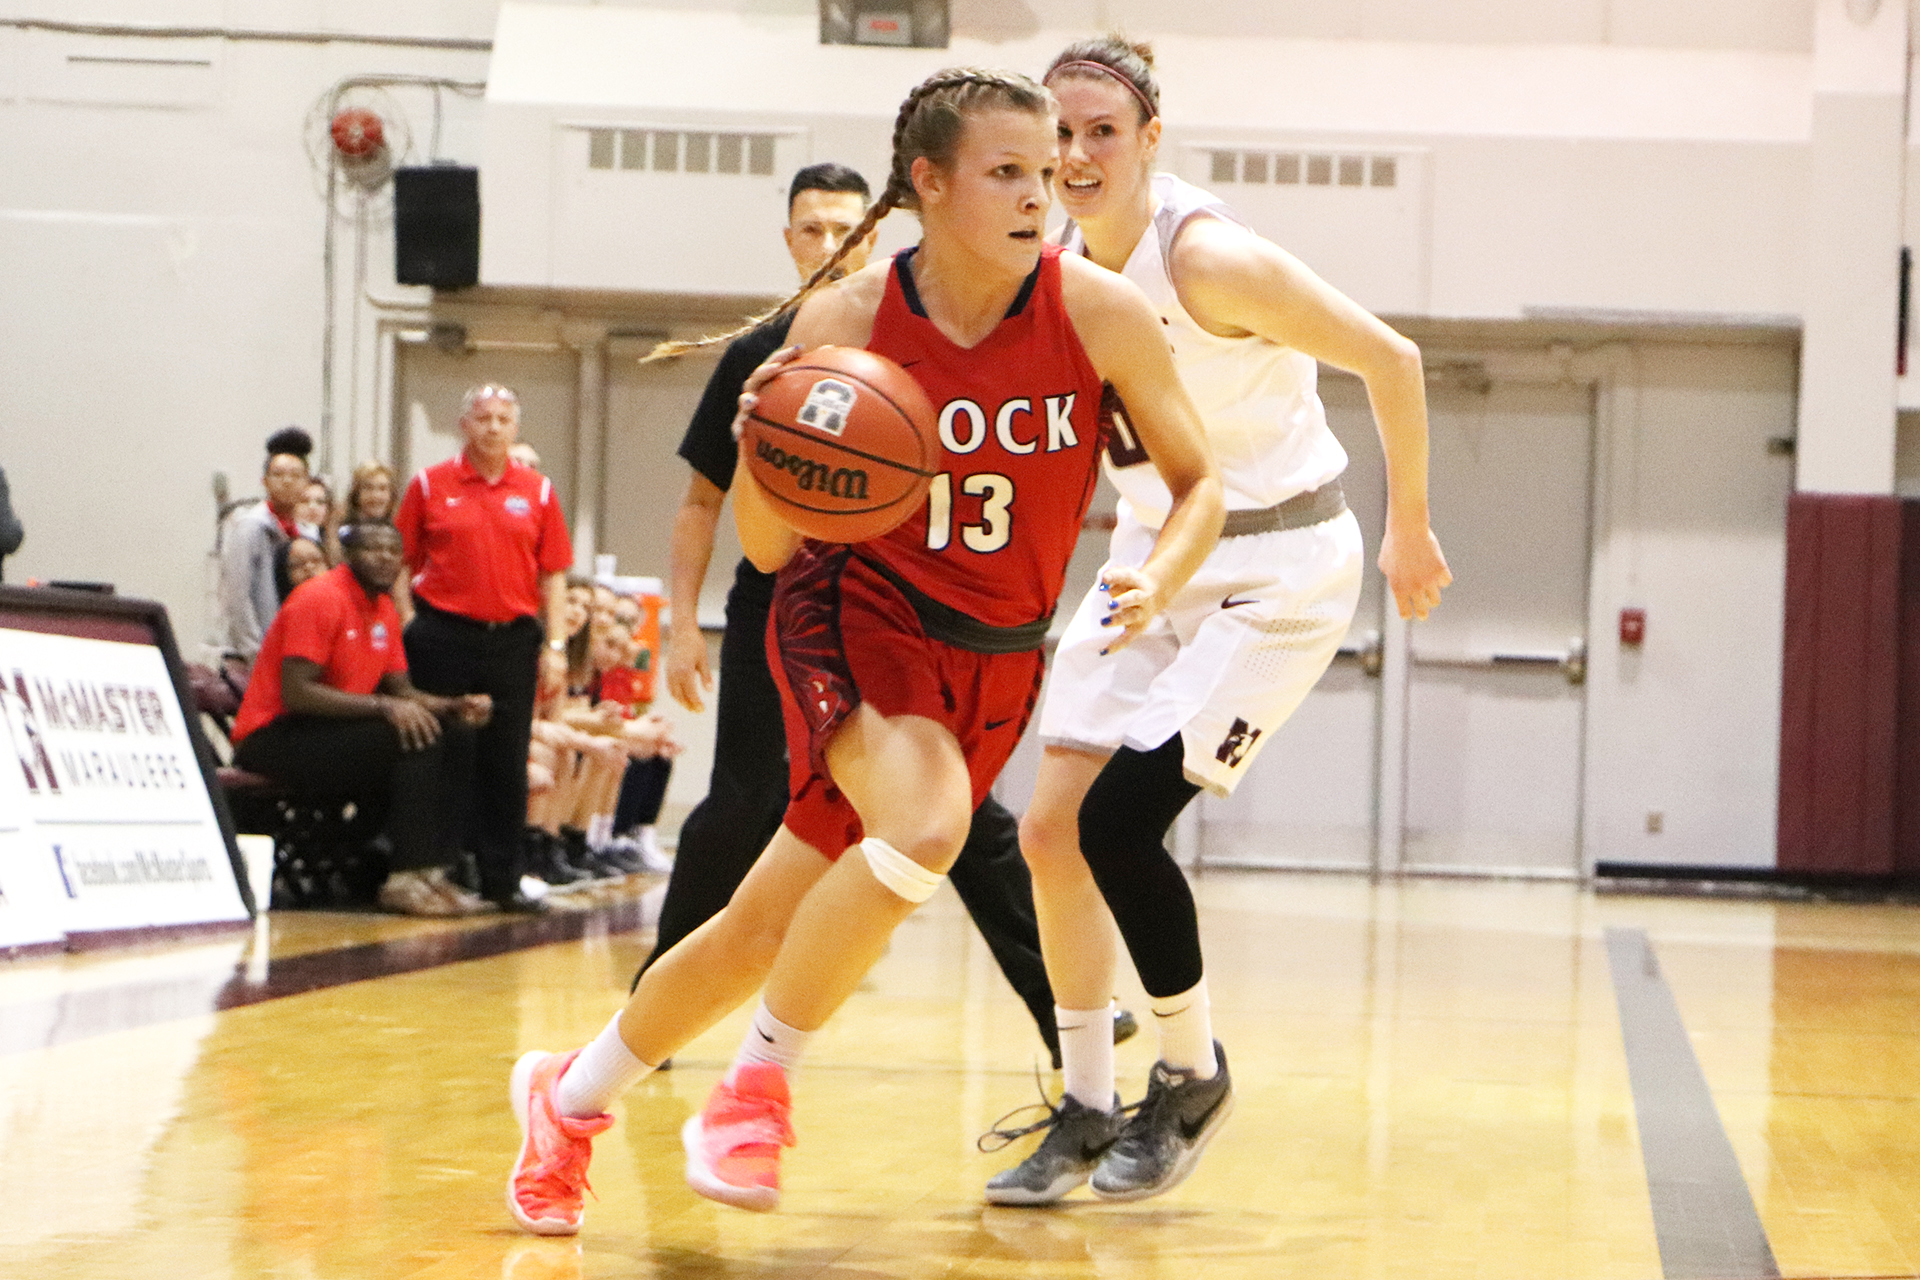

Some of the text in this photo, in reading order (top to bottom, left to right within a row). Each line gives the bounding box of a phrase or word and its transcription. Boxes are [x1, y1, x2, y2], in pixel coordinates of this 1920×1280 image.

[937, 392, 1080, 456] OCK
[756, 437, 869, 500] Wilson
[925, 472, 1015, 555] 13
